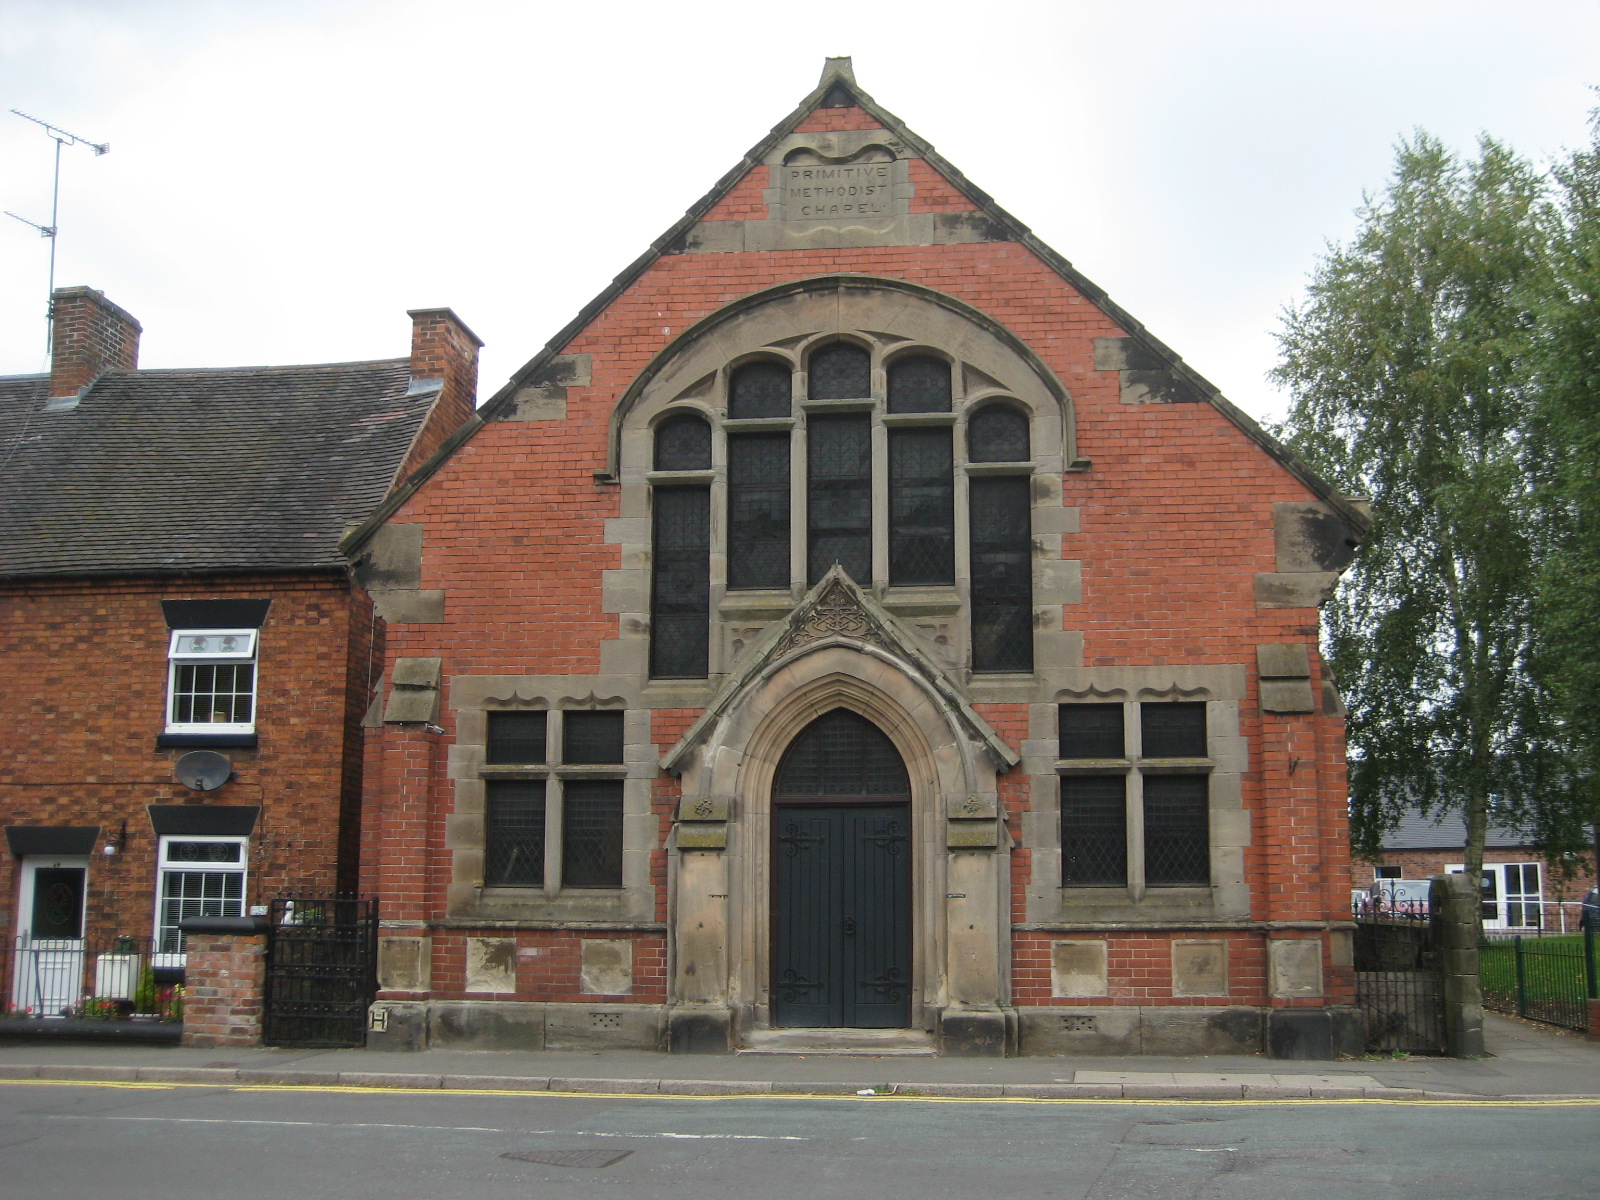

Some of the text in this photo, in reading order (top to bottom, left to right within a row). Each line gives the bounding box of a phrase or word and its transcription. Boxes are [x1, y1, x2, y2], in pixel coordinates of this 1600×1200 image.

[791, 167, 887, 181] PRIMITIVE
[790, 185, 887, 198] METHODIST
[801, 203, 880, 216] CHAPEL
[372, 1011, 385, 1030] H
